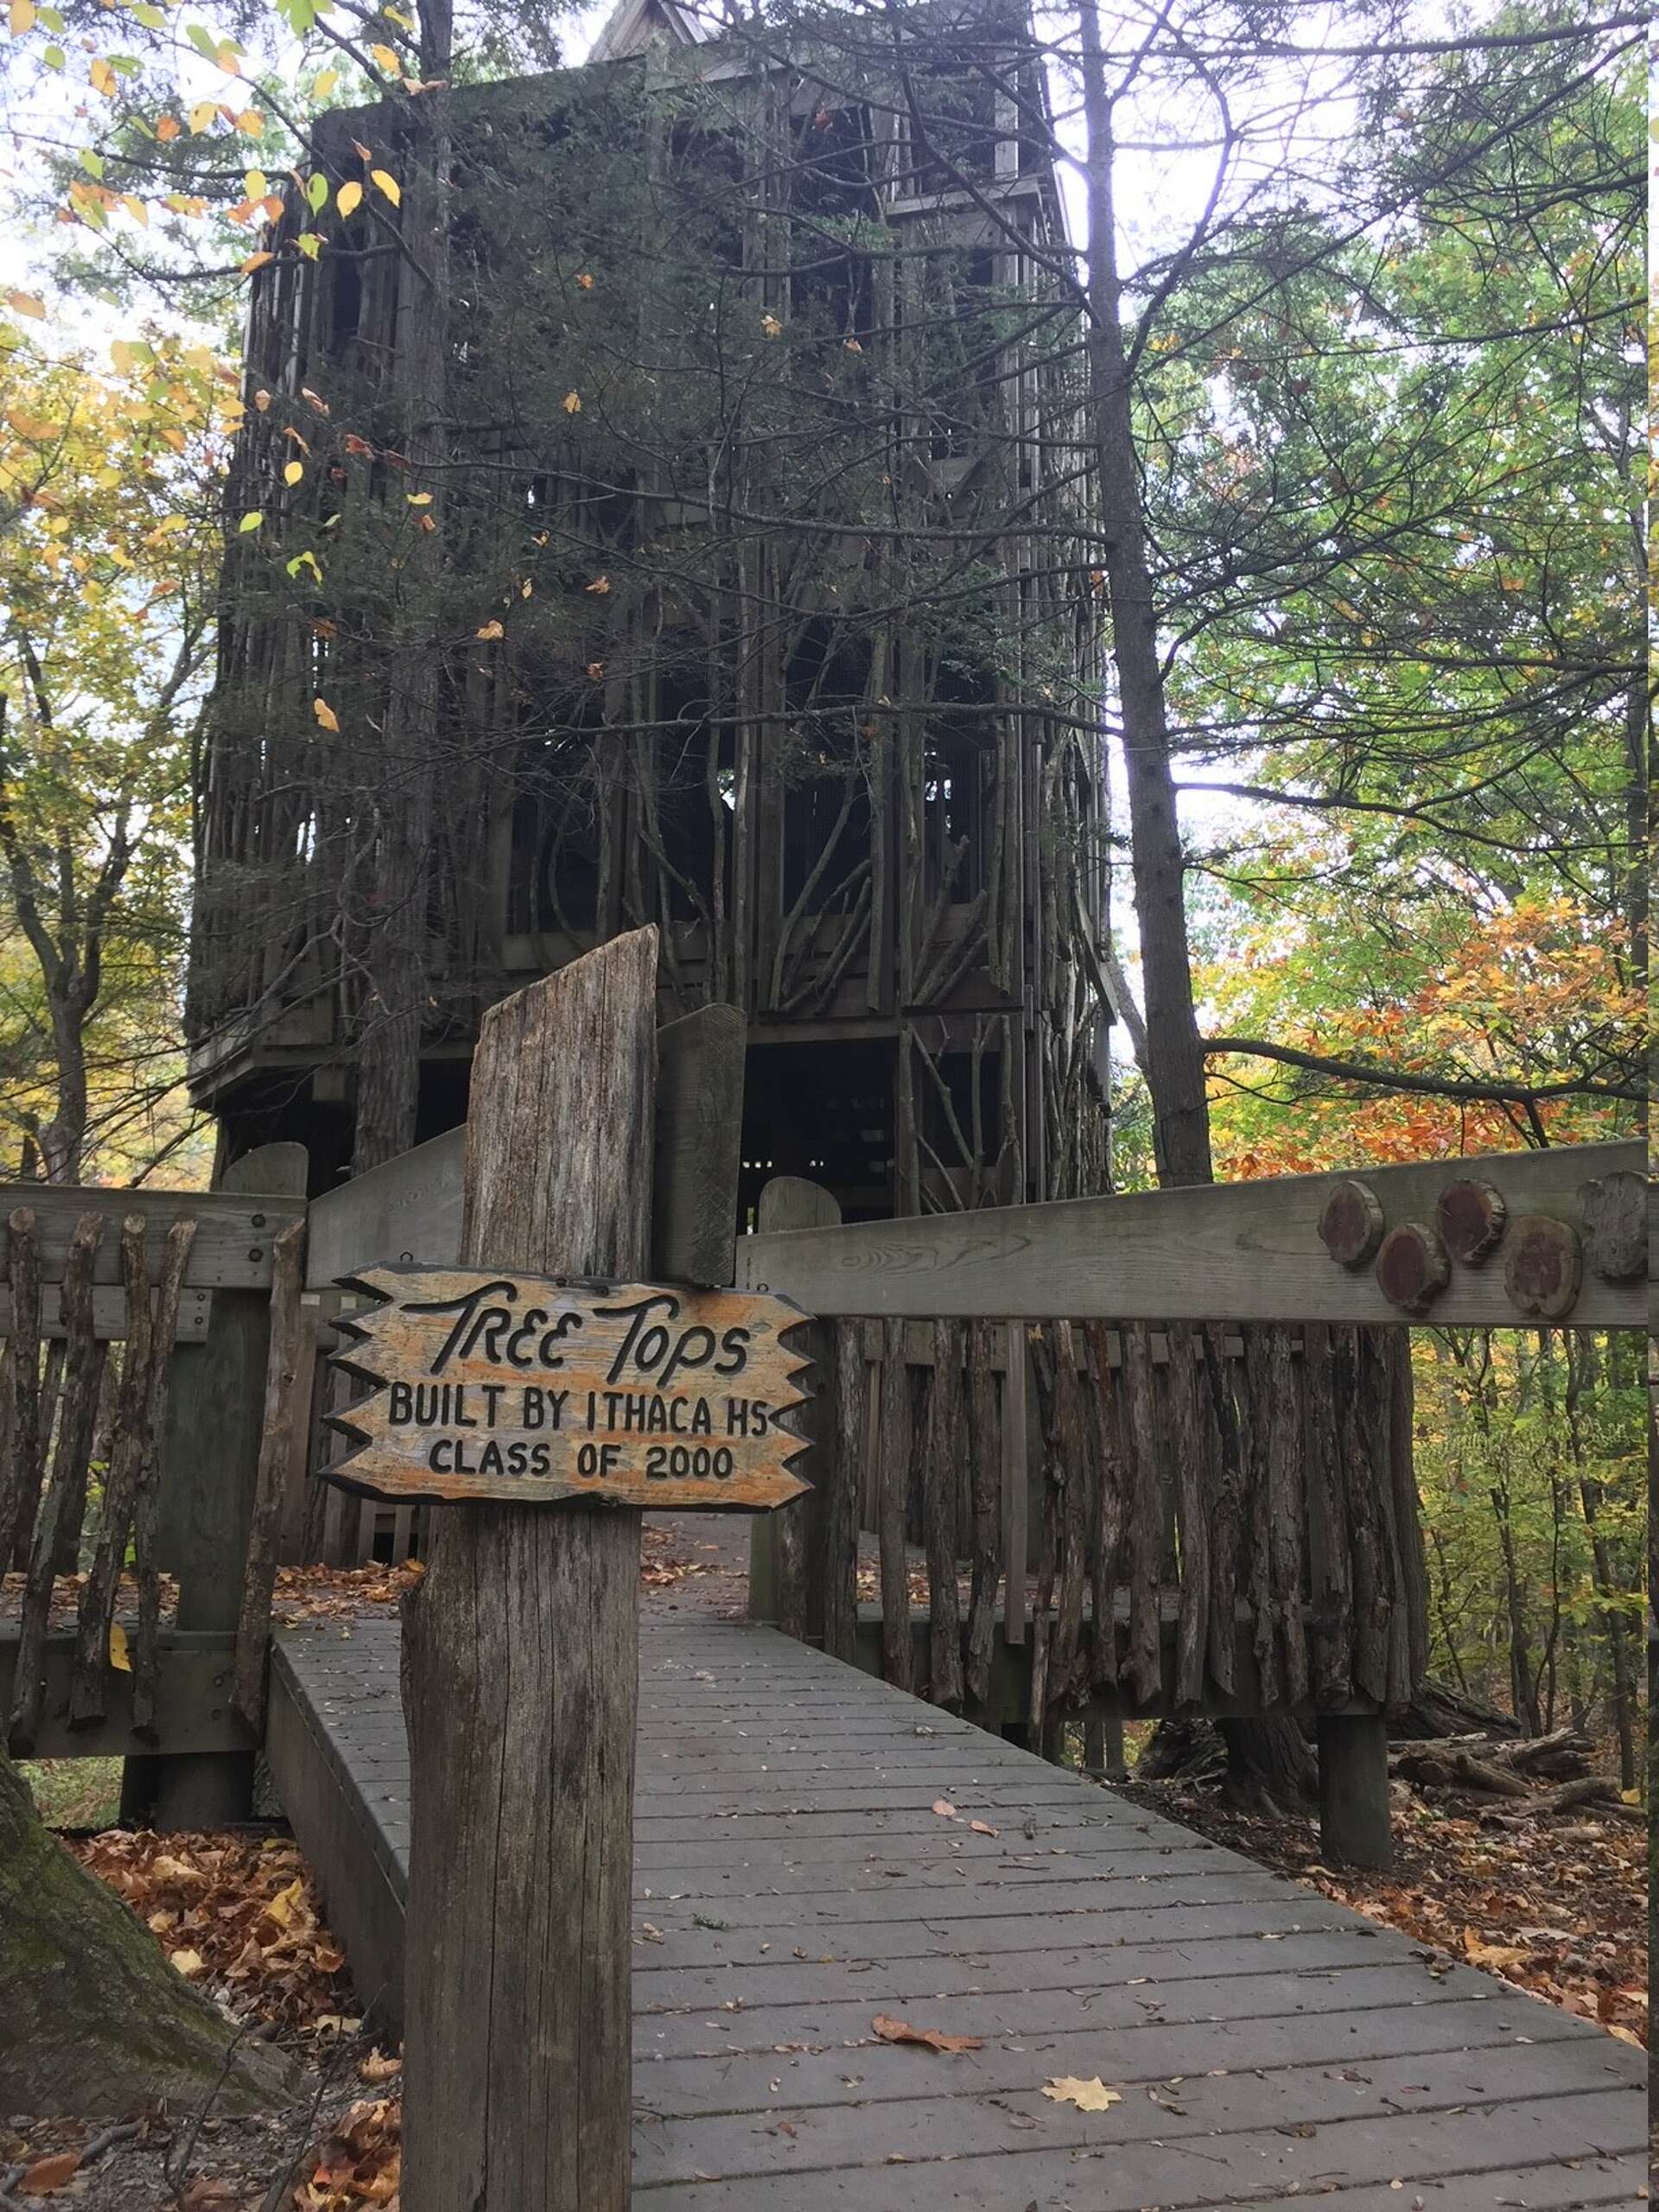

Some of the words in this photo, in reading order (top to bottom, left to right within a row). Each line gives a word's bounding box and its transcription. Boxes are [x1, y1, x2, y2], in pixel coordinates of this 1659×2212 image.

[388, 1382, 505, 1429] BUILT
[523, 1387, 569, 1431] BY
[588, 1391, 711, 1436] ITHACA
[727, 1396, 769, 1437] HS
[429, 1440, 550, 1476] CLASS
[577, 1443, 622, 1478] OF
[645, 1446, 734, 1480] 2000
